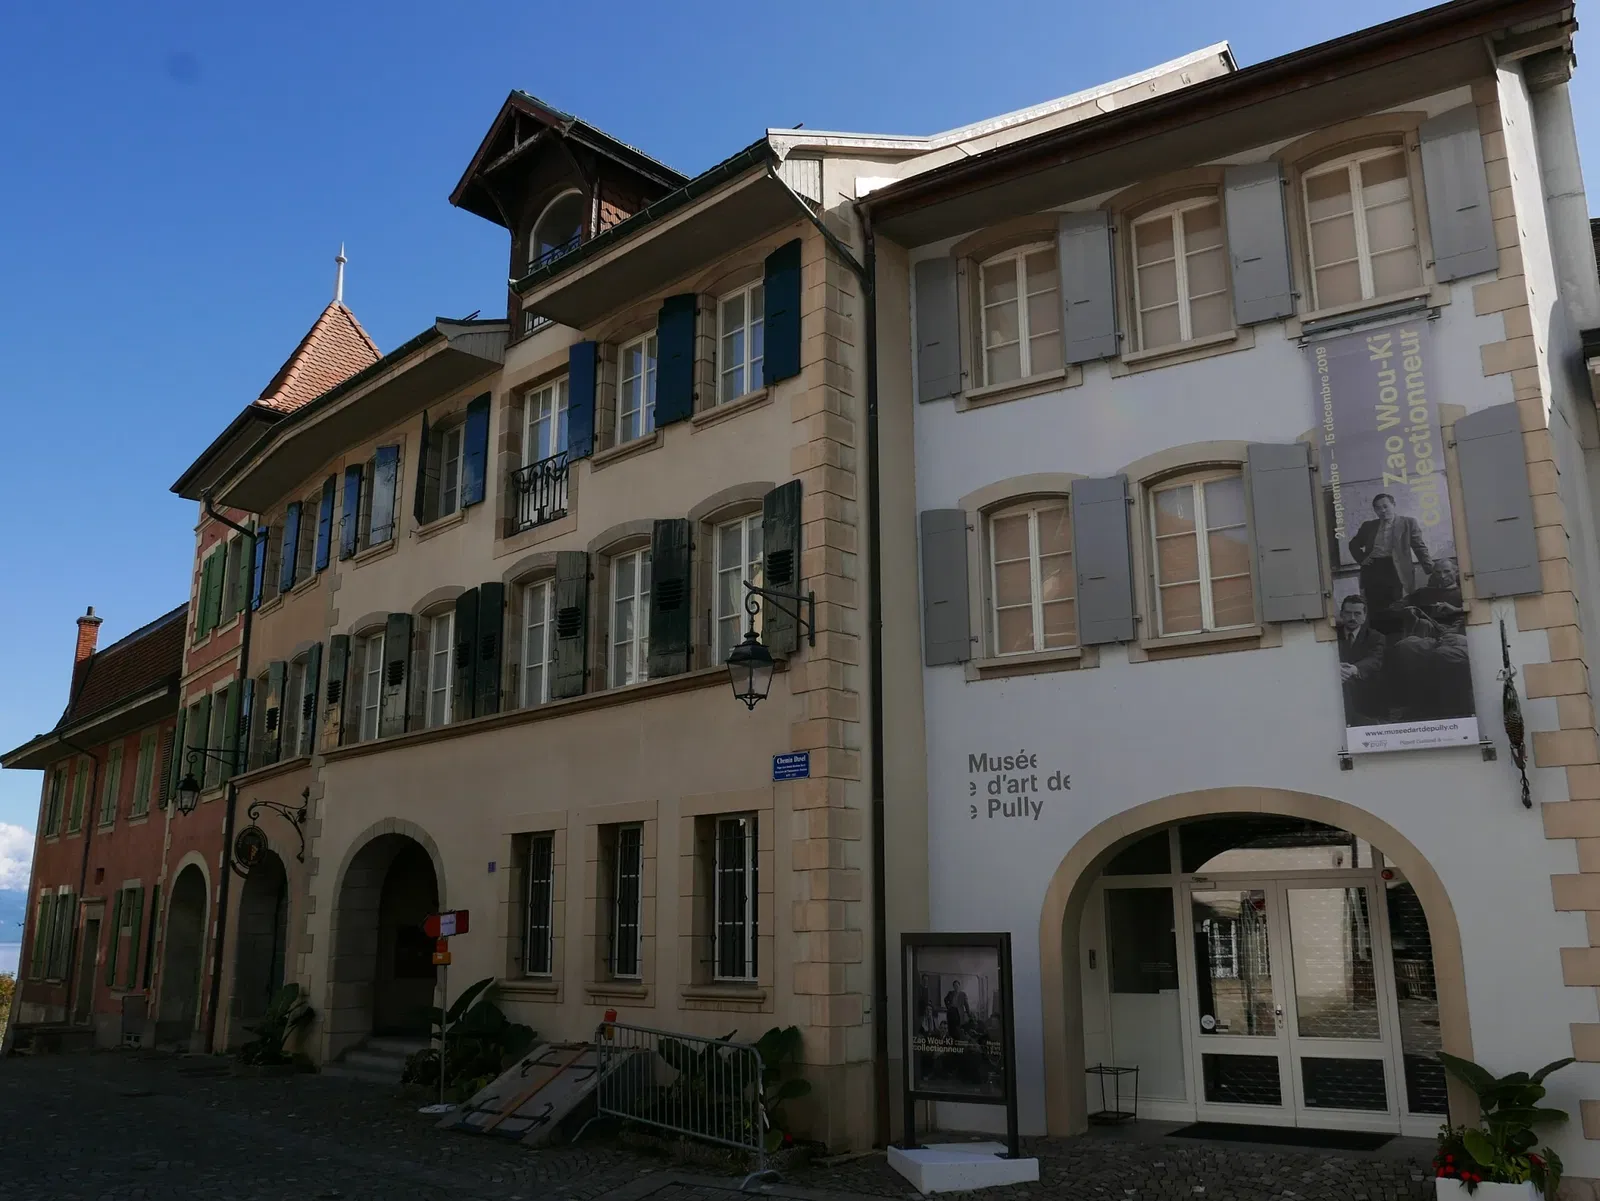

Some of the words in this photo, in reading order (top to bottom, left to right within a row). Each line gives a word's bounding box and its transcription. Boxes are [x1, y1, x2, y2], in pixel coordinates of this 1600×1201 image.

[1316, 347, 1329, 374] 2019
[1367, 332, 1401, 432] Wou-Ki
[1319, 375, 1334, 432] décembre
[1325, 433, 1335, 447] 15
[1400, 329, 1441, 527] collectionneur
[1383, 436, 1408, 487] Zao
[1328, 463, 1345, 523] septembre
[1335, 522, 1345, 539] 21
[1365, 724, 1458, 737] www.museedartdepully.ch
[968, 749, 1037, 773] Musée
[987, 774, 1038, 795] d'art
[1047, 770, 1071, 792] de
[987, 796, 1044, 821] Pully
